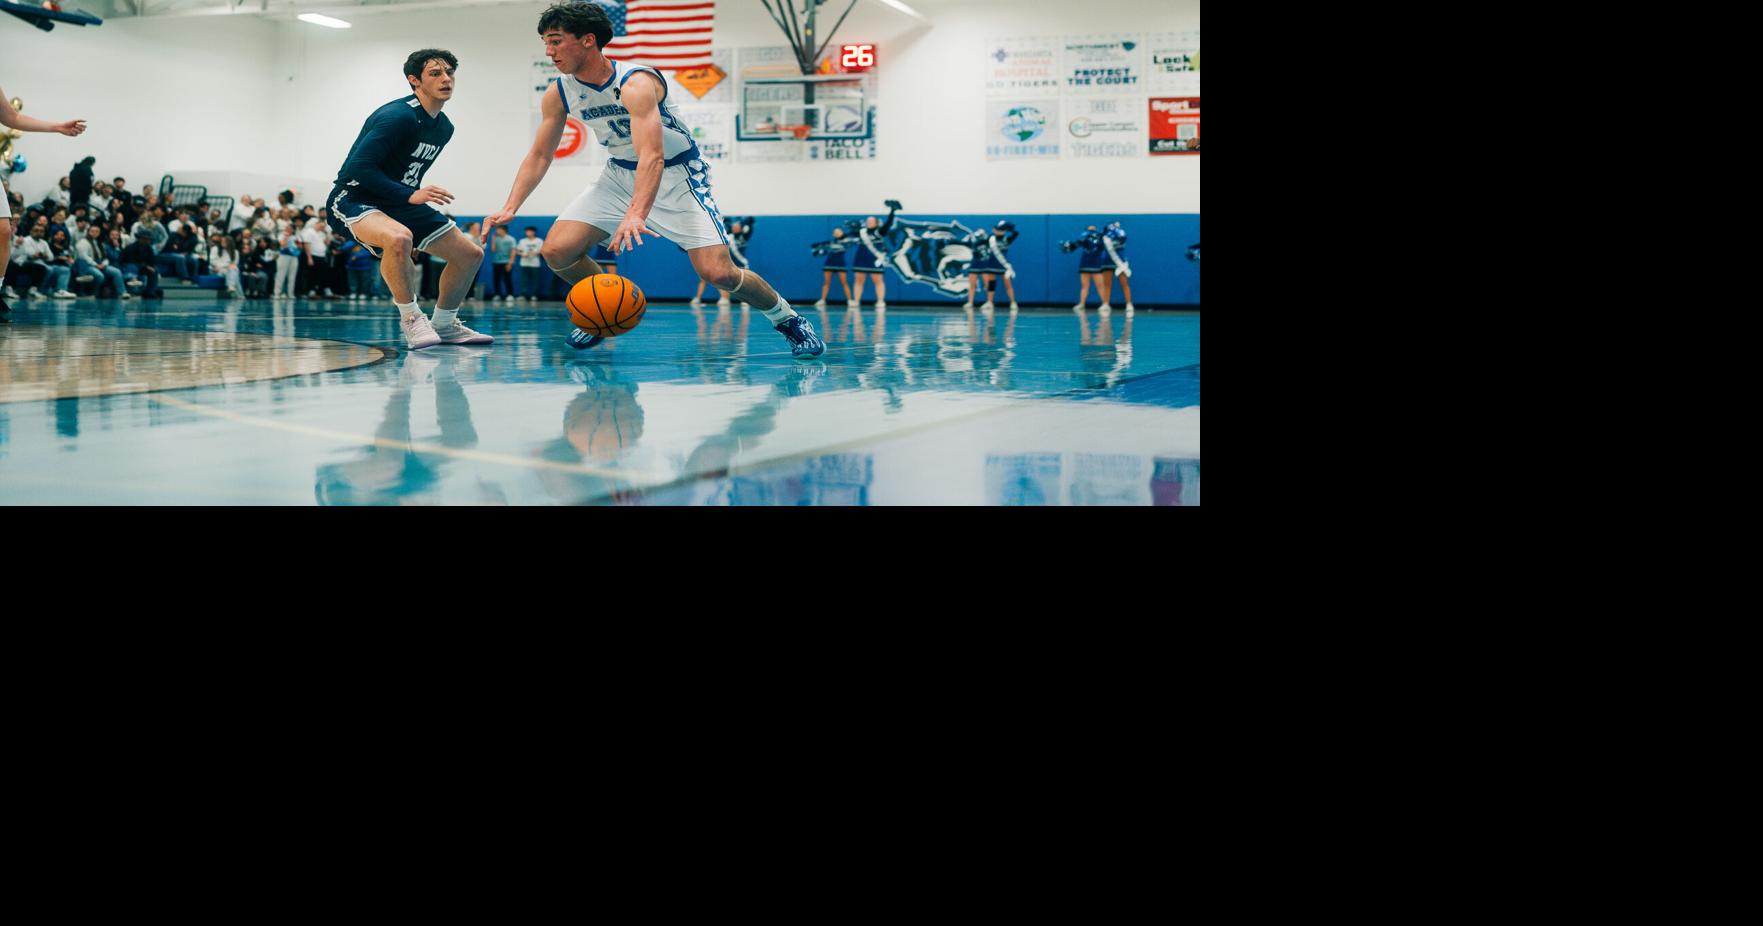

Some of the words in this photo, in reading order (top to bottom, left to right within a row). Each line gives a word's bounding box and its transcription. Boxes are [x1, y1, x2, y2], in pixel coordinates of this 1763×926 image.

[843, 45, 873, 67] 26
[1153, 55, 1190, 64] Lock
[1074, 68, 1130, 76] PROTECT
[1011, 79, 1058, 87] TIGERS
[1067, 78, 1091, 86] THE
[1096, 76, 1138, 85] COURT
[825, 149, 863, 159] BELL
